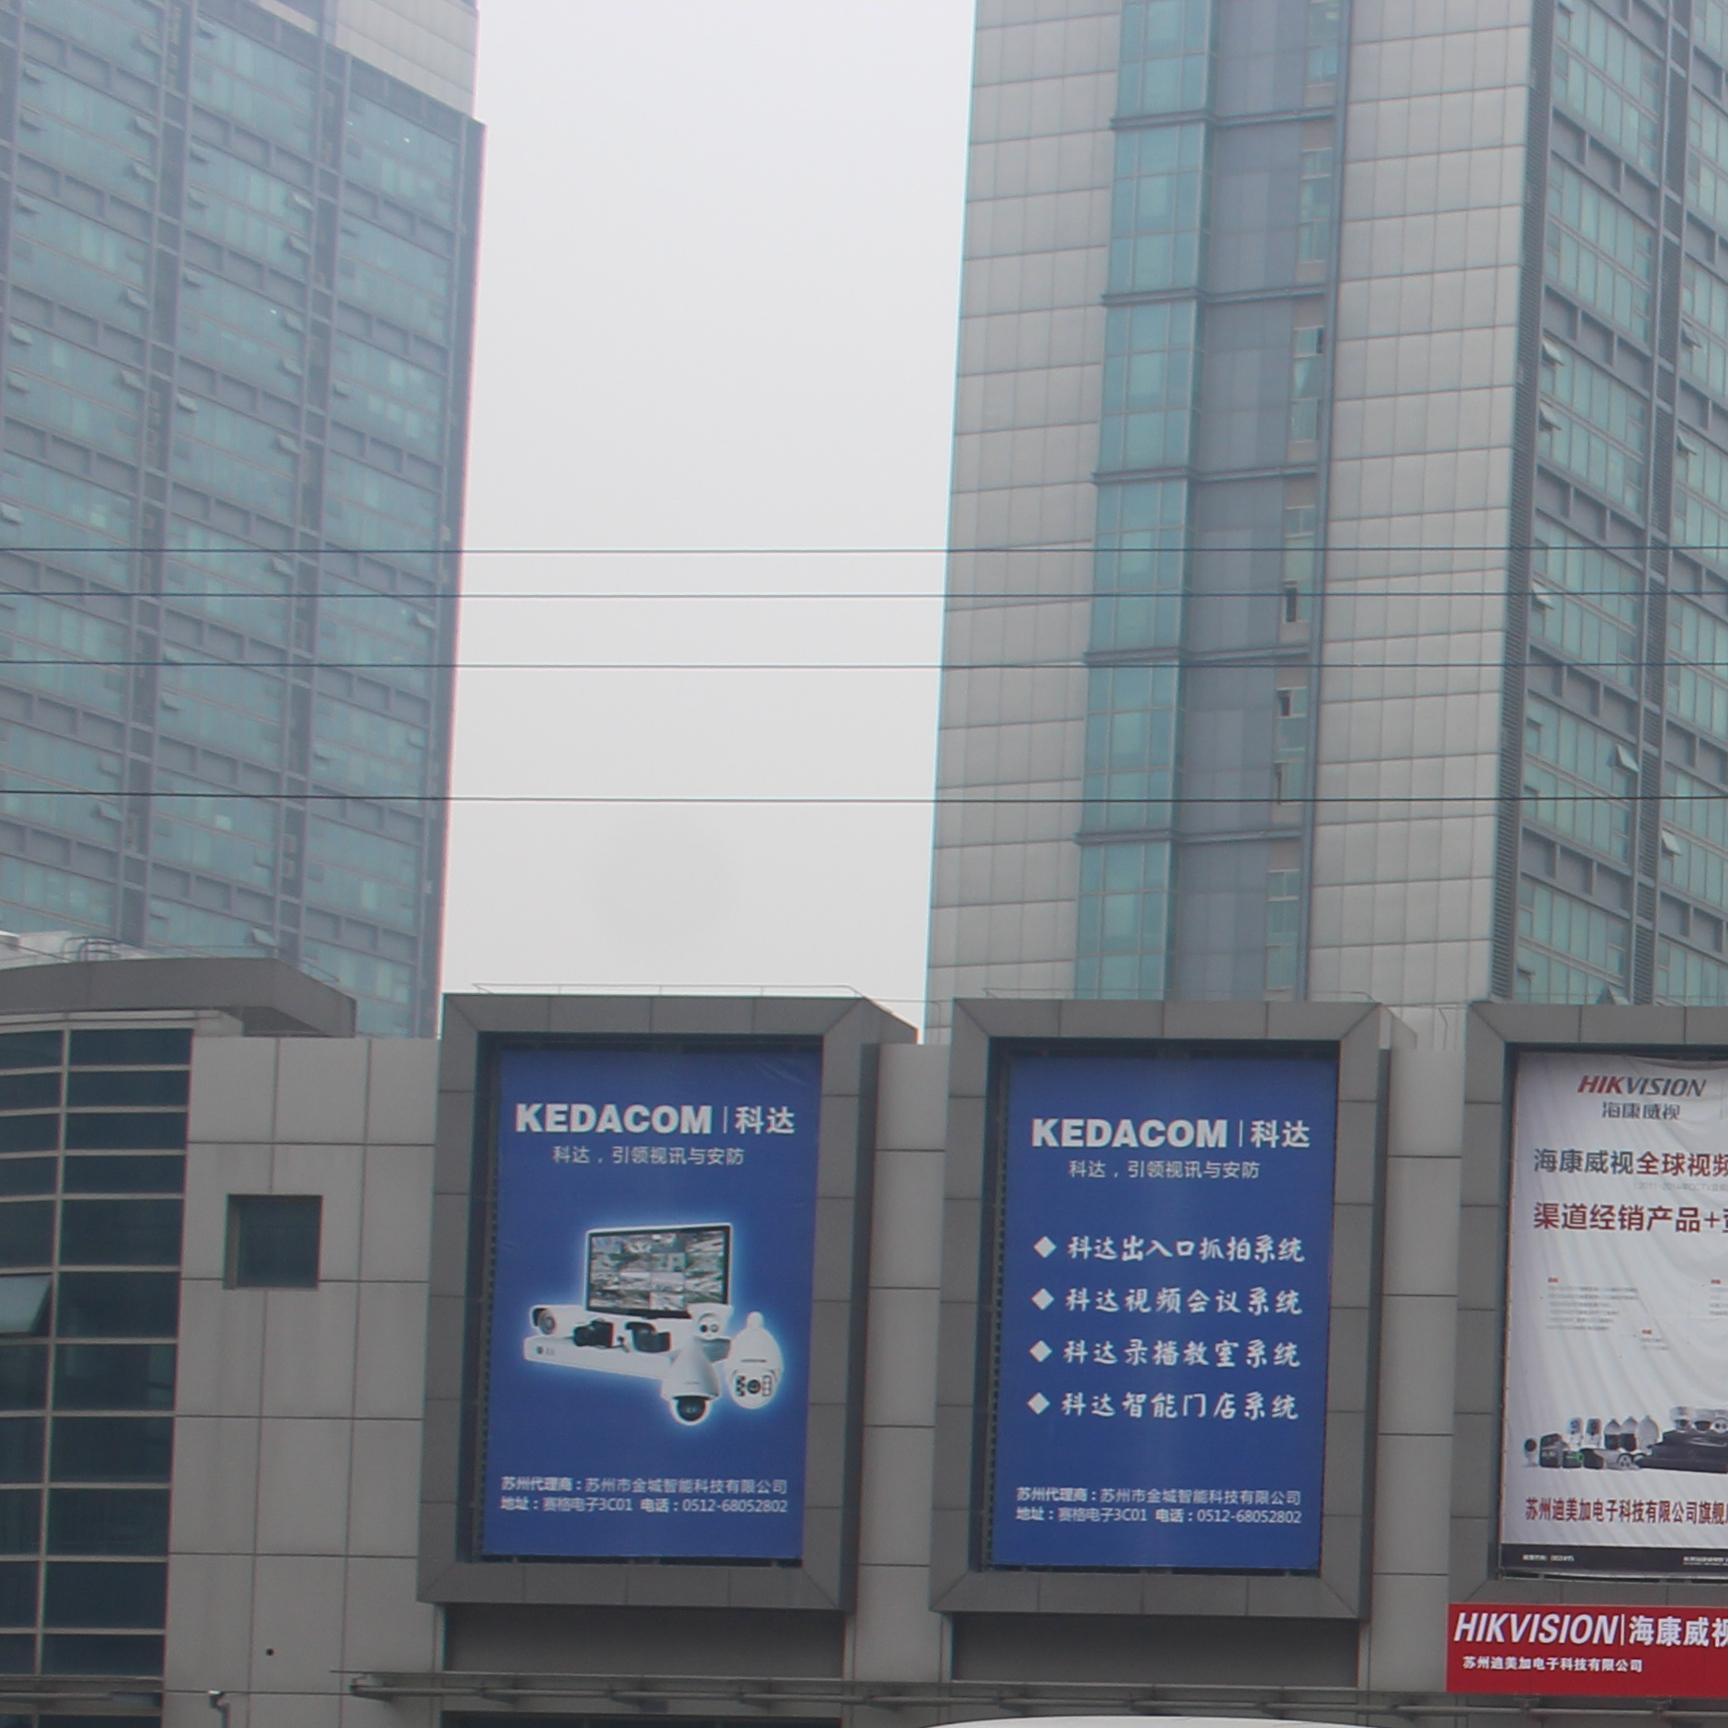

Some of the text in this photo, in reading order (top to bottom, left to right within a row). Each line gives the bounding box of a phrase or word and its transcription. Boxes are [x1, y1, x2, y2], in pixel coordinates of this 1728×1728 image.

[1577, 1074, 1707, 1098] HIKVISION
[516, 1103, 795, 1135] KEDACOM 科达
[1032, 1118, 1311, 1148] KEDACOM 科达
[1067, 1234, 1306, 1263] 科达出入口抓拍系统
[1063, 1339, 1302, 1368] 科达录播教室系统
[1061, 1391, 1300, 1421] 科达智能门店系统
[1453, 1612, 1619, 1645] HIKVISION
[1463, 1655, 1643, 1673] 苏州迪美加电子科技有限公司
